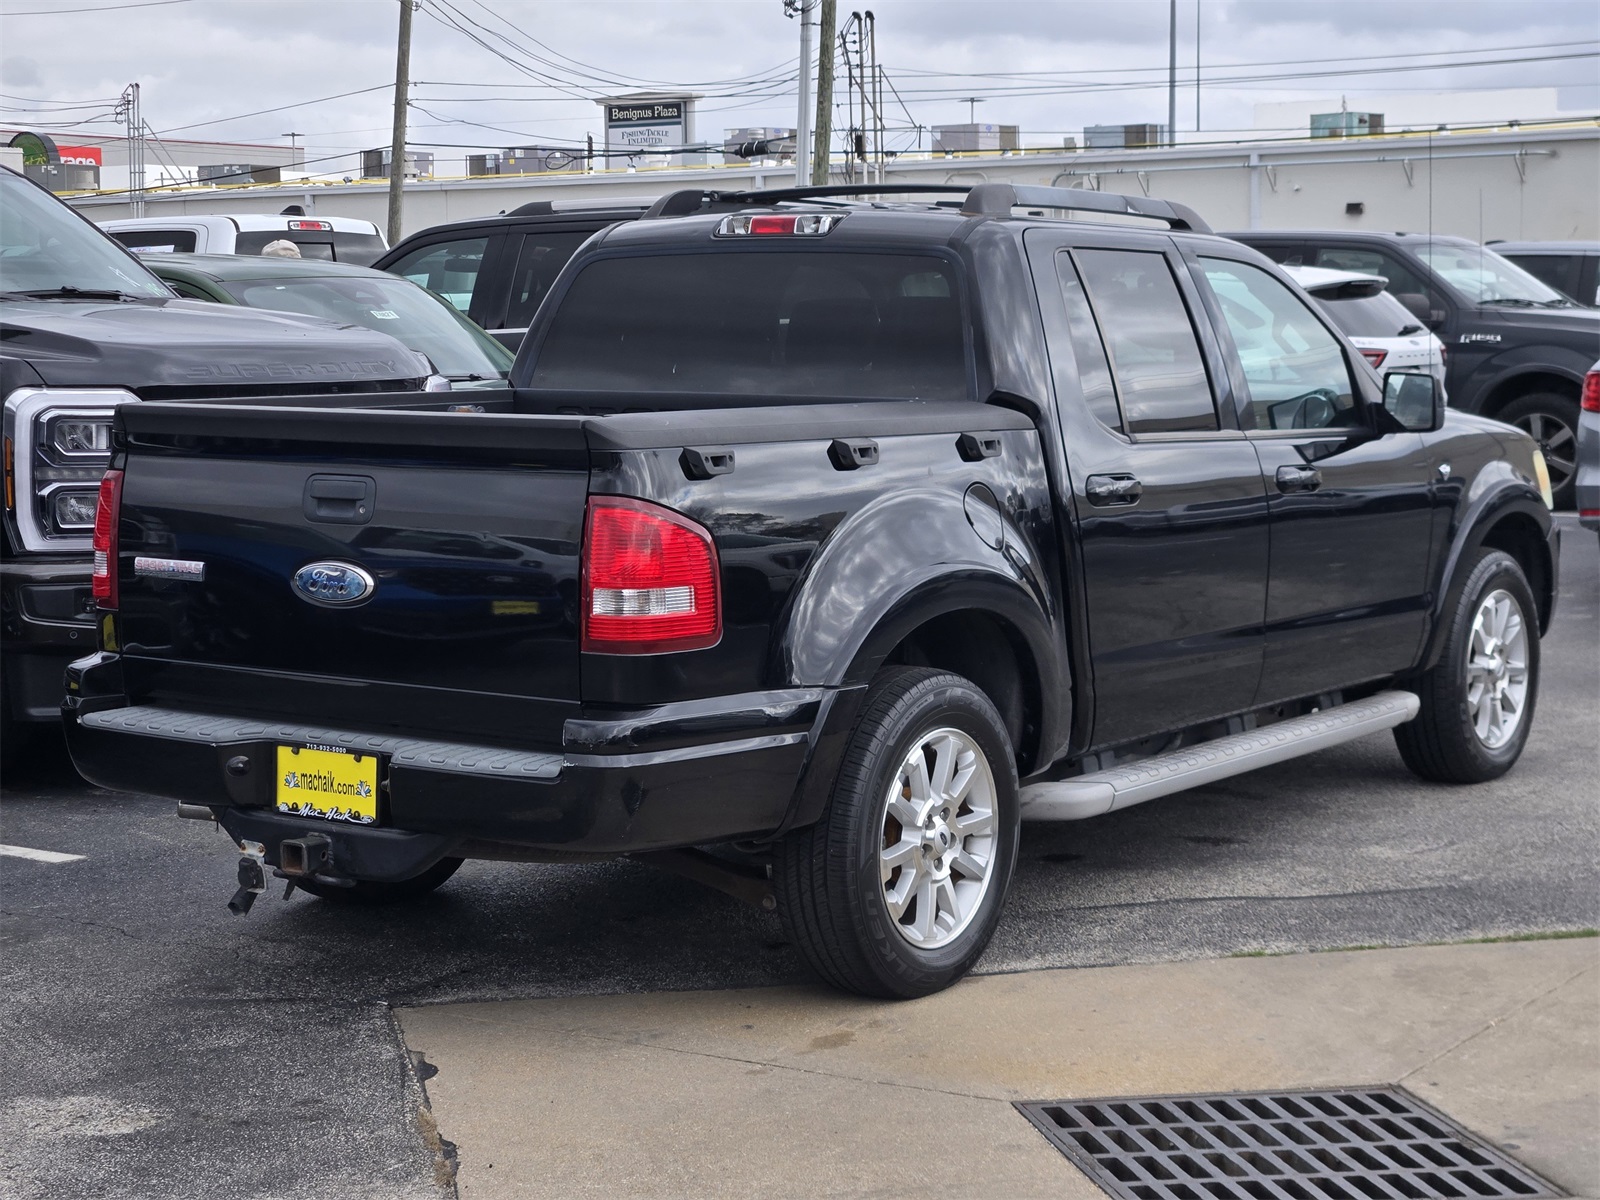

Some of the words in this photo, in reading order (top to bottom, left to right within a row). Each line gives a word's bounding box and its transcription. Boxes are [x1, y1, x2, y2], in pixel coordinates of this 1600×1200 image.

[612, 108, 652, 120] Benignus
[654, 105, 678, 117] Plaza
[621, 130, 646, 140] FISHING
[646, 128, 670, 137] TACKLE
[187, 362, 316, 379] SUPER
[319, 360, 396, 374] DUTY
[306, 568, 351, 595] Ford
[306, 743, 347, 754] 713-932-5000
[300, 769, 355, 796] machaik.com
[298, 802, 325, 818] Mac
[324, 806, 356, 821] Haik
